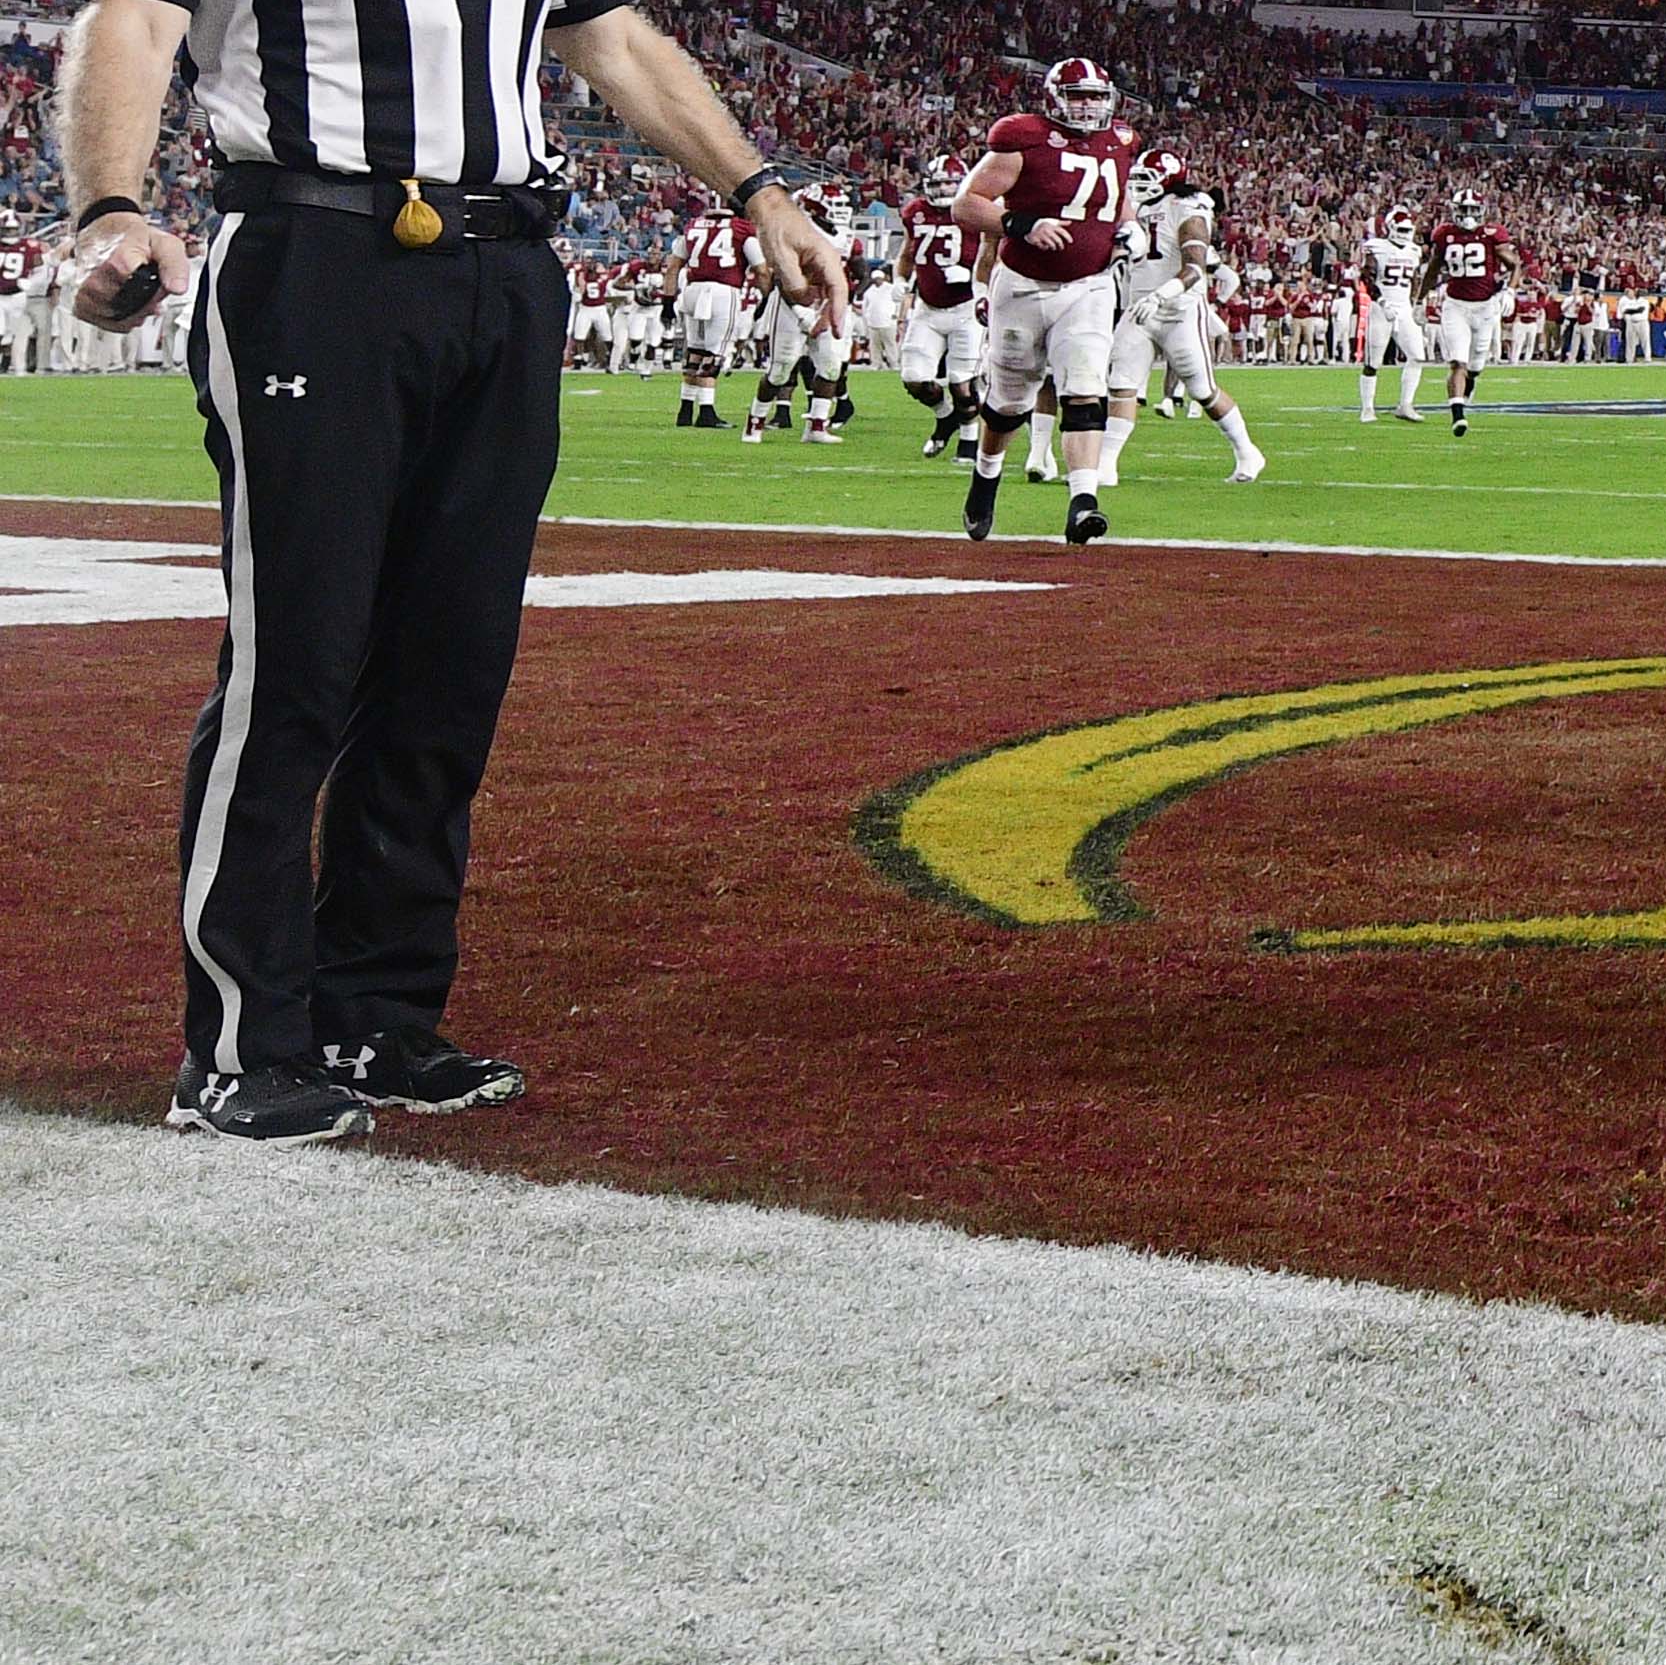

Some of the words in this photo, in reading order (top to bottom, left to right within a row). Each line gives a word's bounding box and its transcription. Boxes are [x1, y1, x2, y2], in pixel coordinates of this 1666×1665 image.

[1060, 151, 1120, 223] 71
[687, 228, 737, 268] 74
[913, 224, 963, 266] 73
[1445, 243, 1487, 278] 82
[1382, 264, 1414, 287] 55
